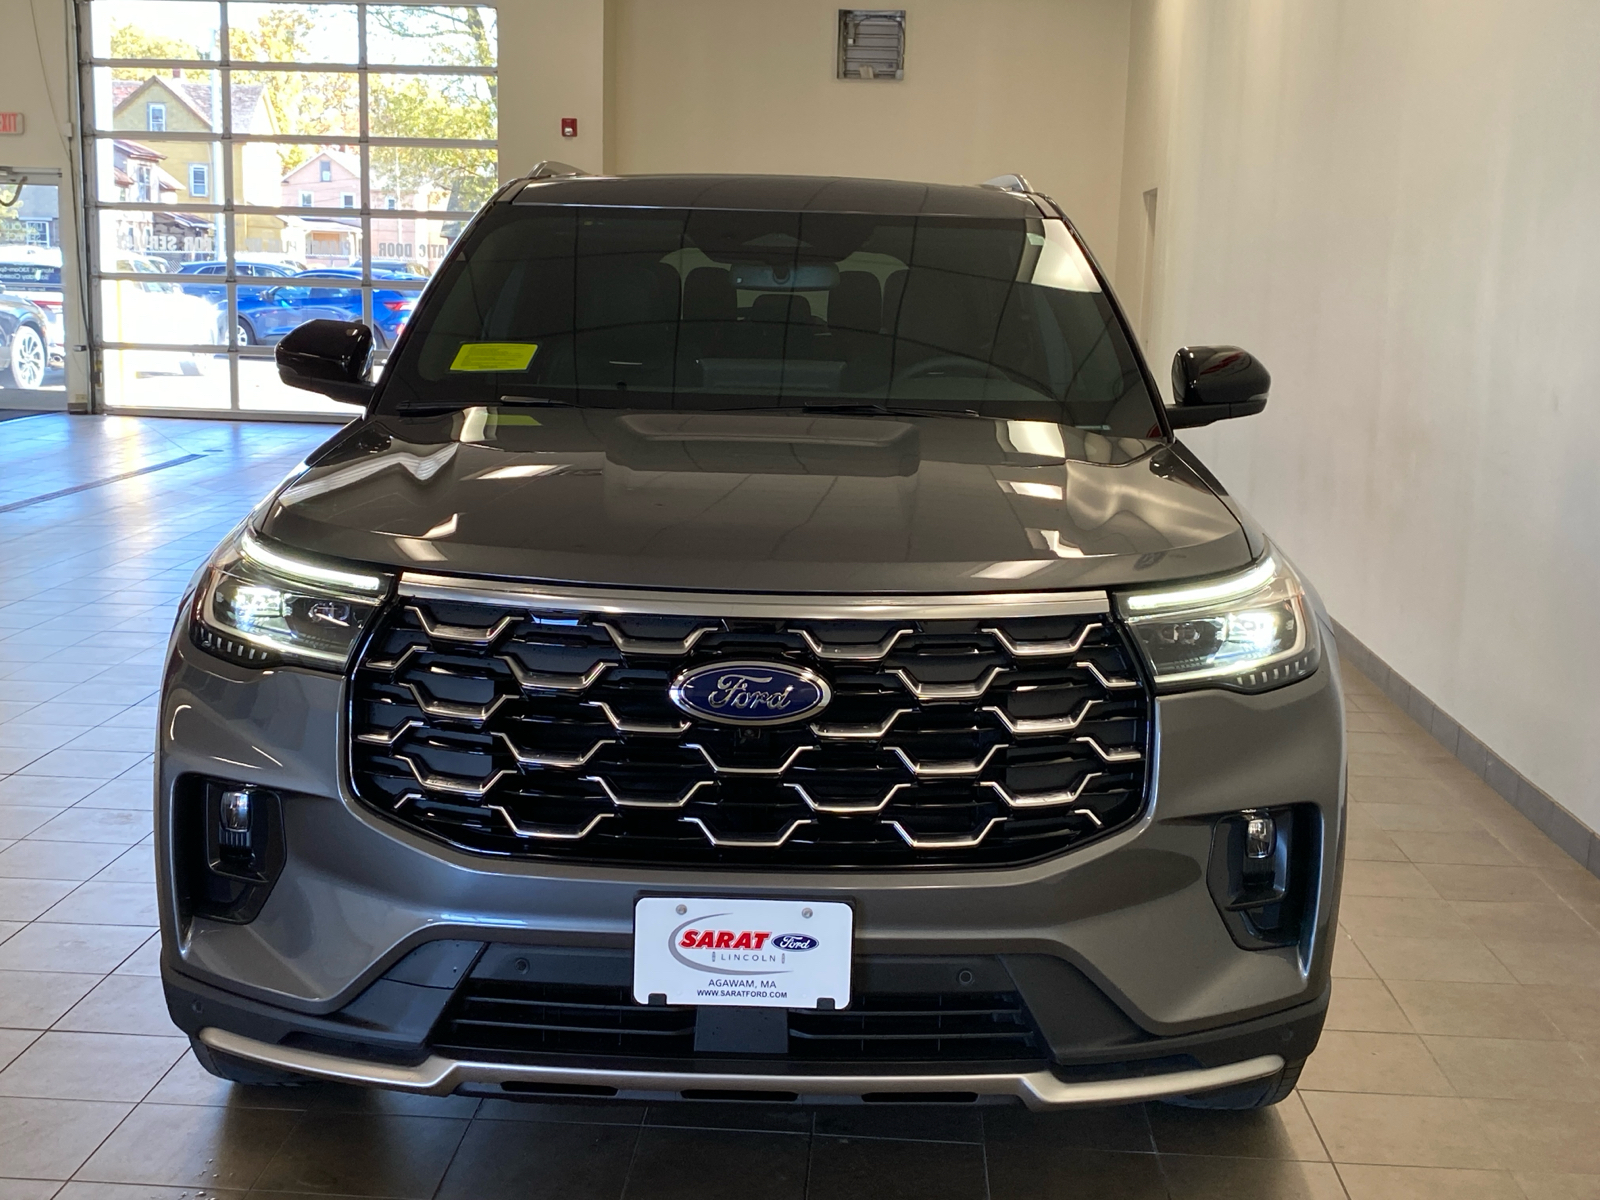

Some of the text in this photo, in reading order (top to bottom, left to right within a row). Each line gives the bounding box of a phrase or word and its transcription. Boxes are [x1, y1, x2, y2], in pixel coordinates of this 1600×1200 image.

[0, 113, 18, 131] XIT
[707, 673, 794, 711] Ford
[678, 929, 811, 951] SARAT Ford
[720, 953, 776, 962] LINCOLN
[708, 979, 777, 989] AGAWAM, MA
[696, 989, 788, 999] WWW.SARATFORD.COM
